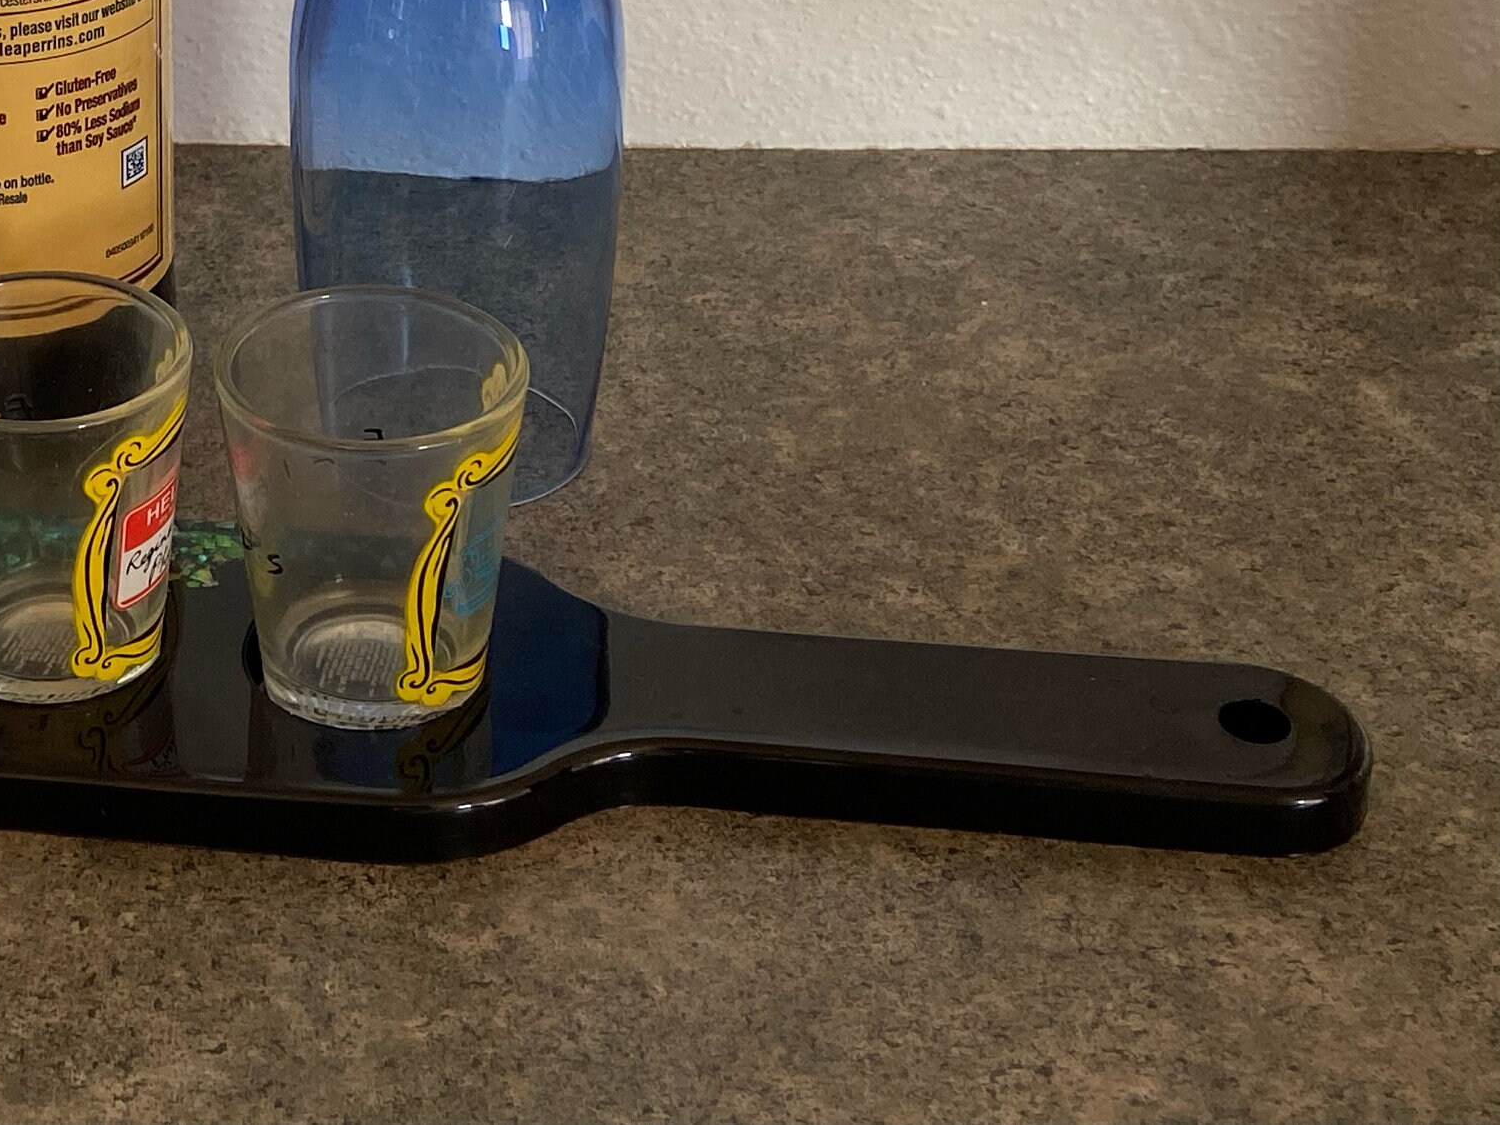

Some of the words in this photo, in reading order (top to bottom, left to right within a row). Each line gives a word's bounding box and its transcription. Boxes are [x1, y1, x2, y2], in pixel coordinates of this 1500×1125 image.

[10, 21, 52, 40] please
[54, 13, 80, 30] visit
[81, 9, 100, 24] our
[55, 67, 117, 96] Gluten-Free
[55, 101, 71, 117] No
[74, 77, 138, 114] Preservatives
[56, 119, 83, 138] 80%
[84, 114, 108, 131] Less
[109, 97, 141, 122] Sodium
[56, 139, 83, 156] than
[85, 131, 105, 148] Soy
[3, 177, 18, 189] on
[20, 172, 55, 187] bottle.
